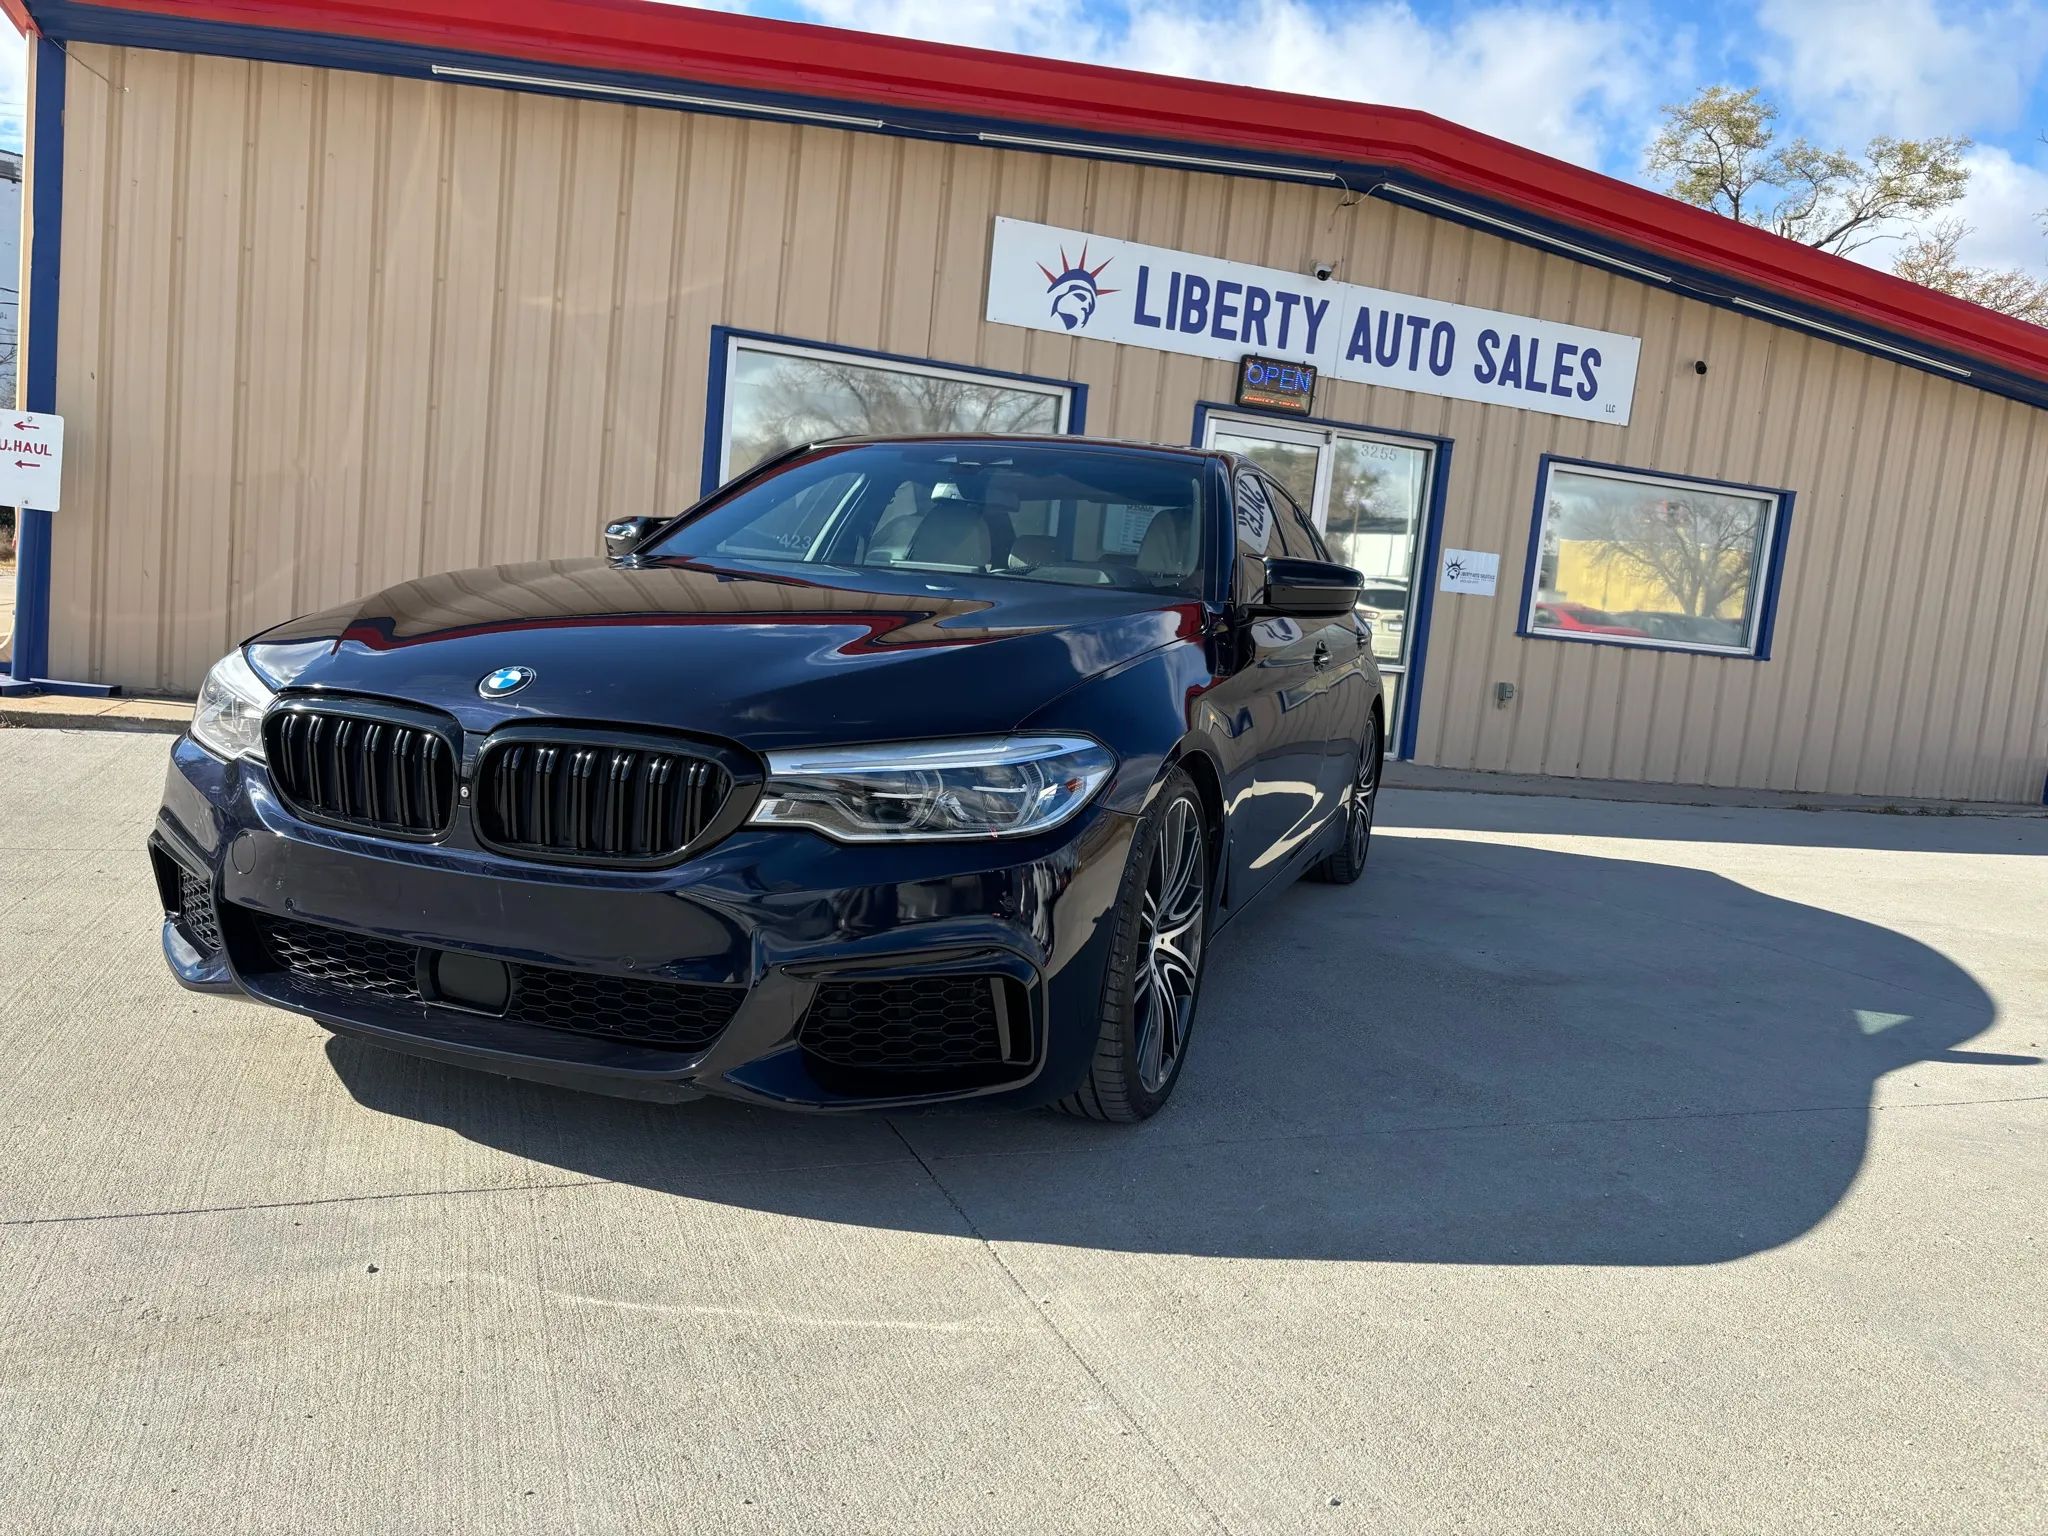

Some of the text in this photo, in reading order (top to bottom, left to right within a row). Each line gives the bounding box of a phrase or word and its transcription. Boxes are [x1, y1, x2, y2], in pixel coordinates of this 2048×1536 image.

[1133, 265, 1602, 402] LIBERTY AUTO SALES
[1247, 363, 1312, 393] OPEN
[1605, 403, 1616, 414] LLC
[1360, 443, 1397, 462] 3255
